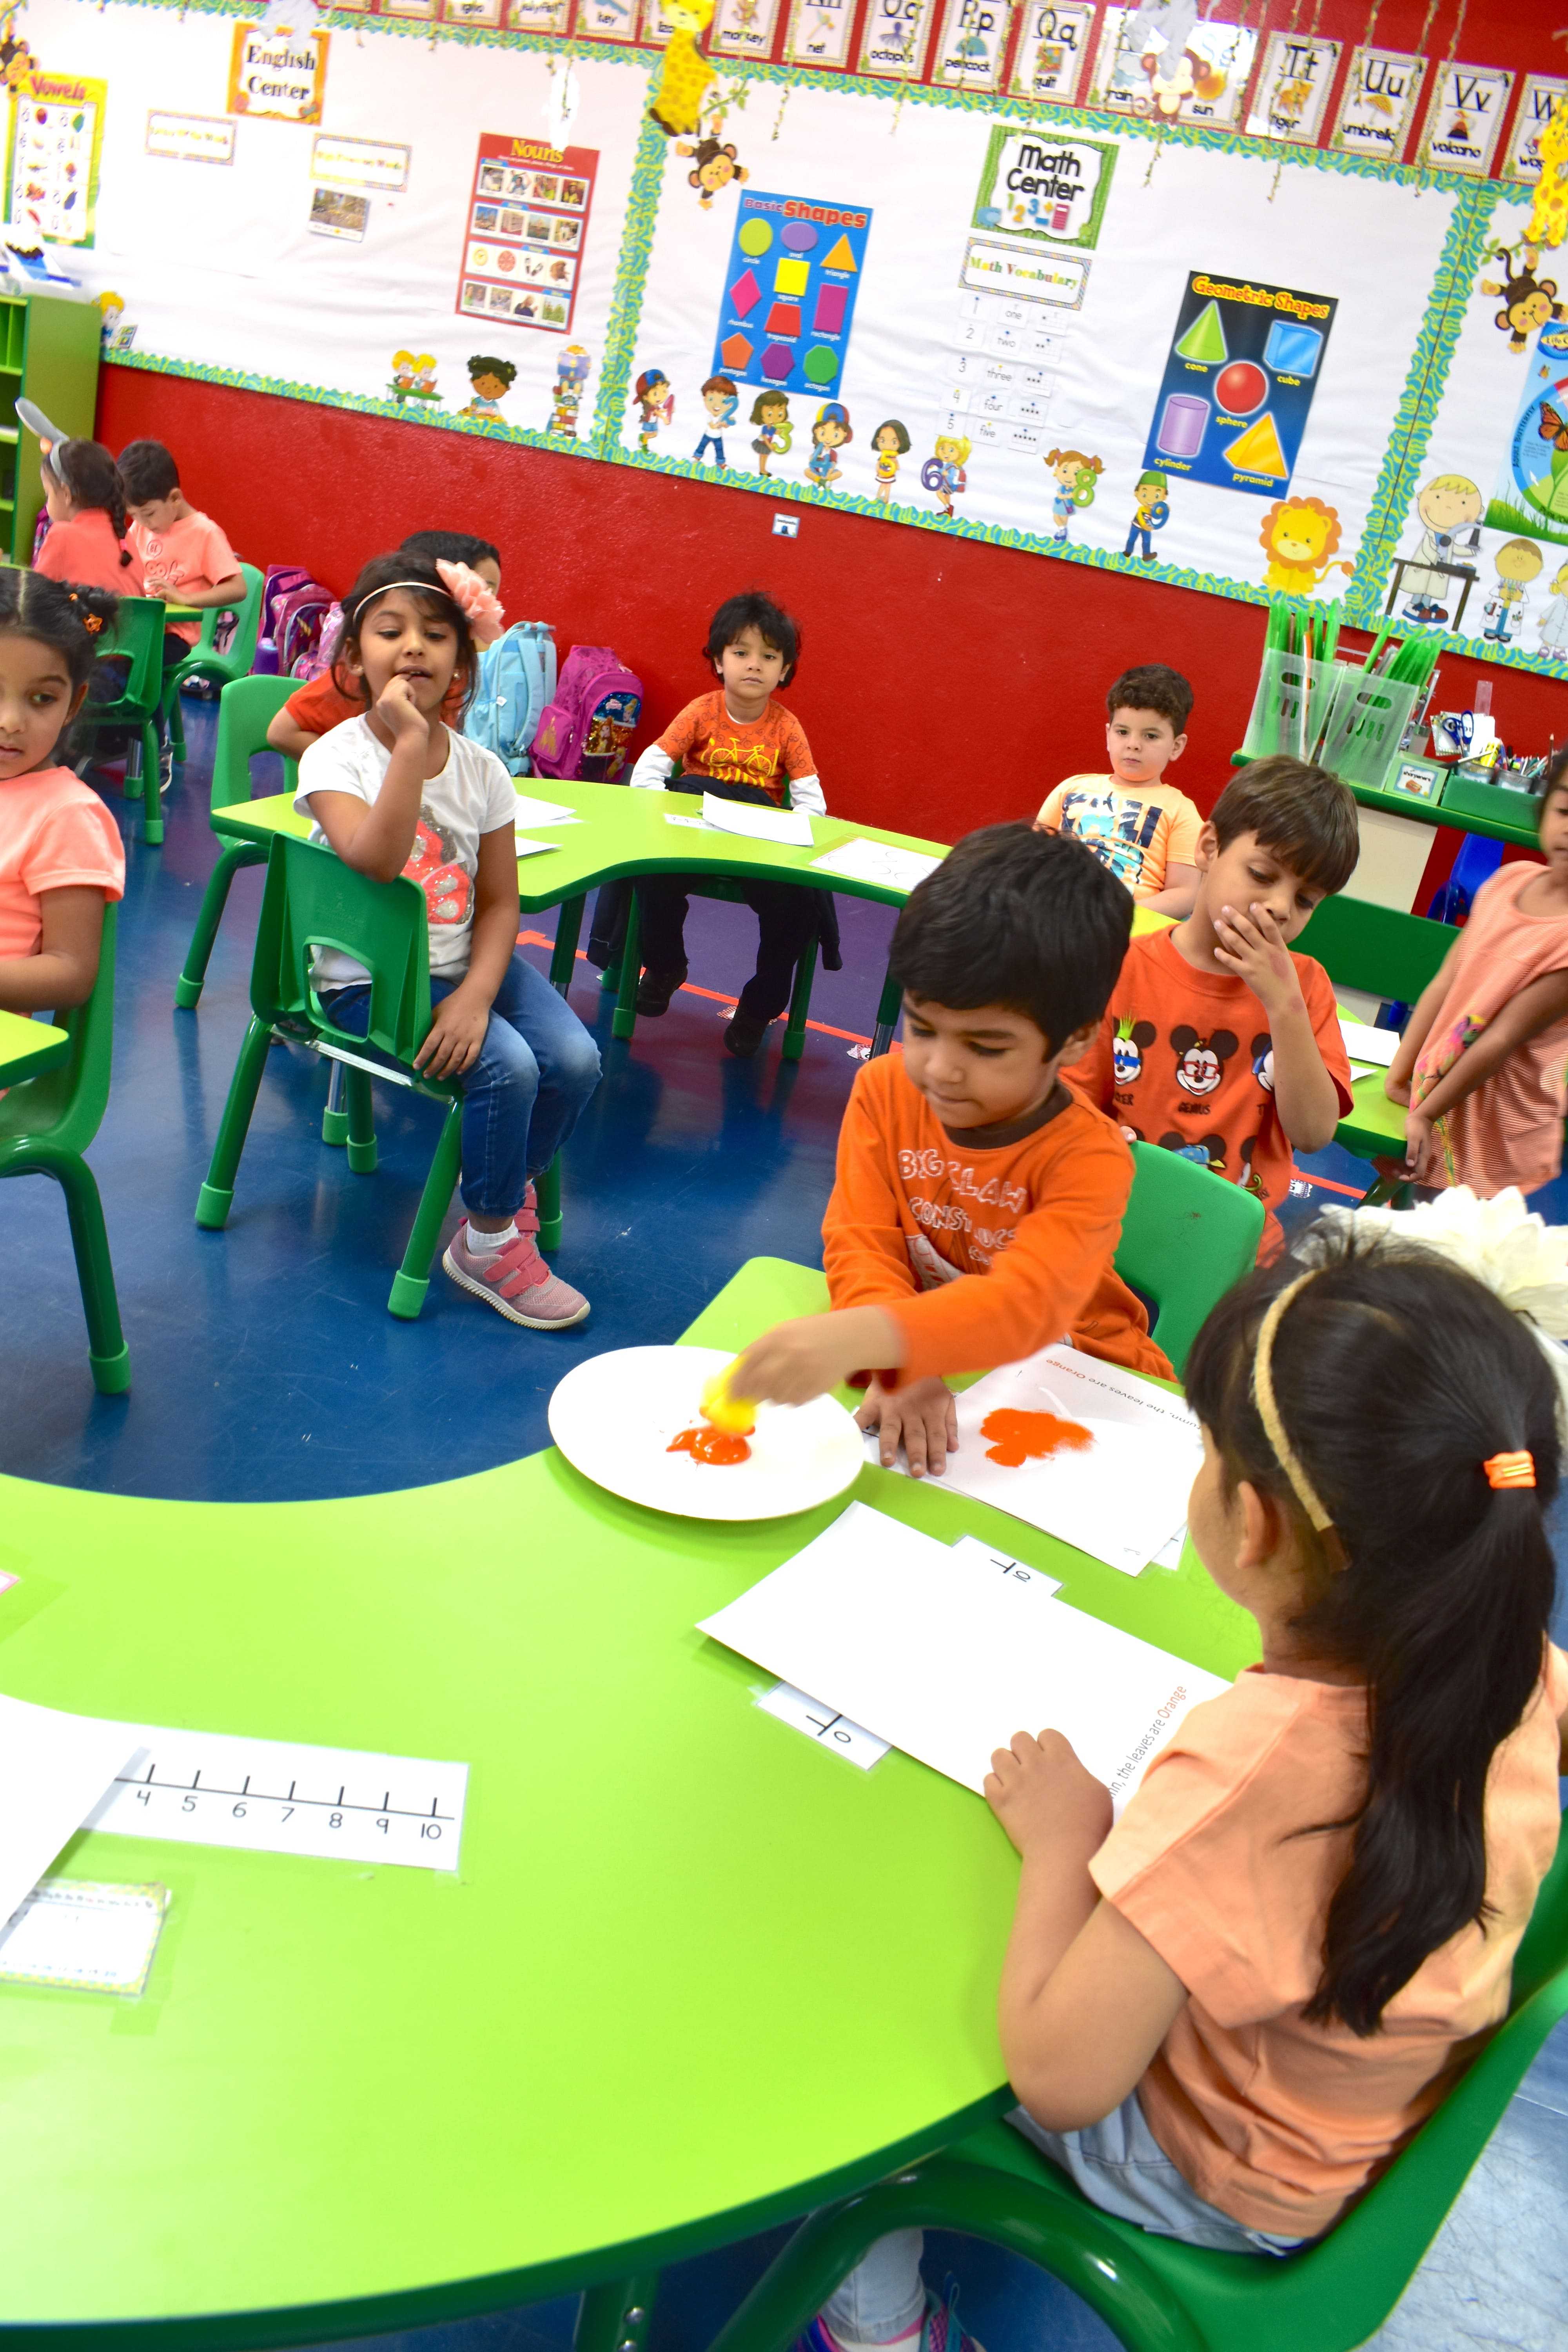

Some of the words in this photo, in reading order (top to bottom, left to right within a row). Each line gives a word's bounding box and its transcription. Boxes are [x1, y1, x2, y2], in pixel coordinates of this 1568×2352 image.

[598, 11, 617, 26] key
[722, 30, 766, 45] mokey
[1038, 10, 1077, 51] Qq
[807, 43, 826, 54] net
[247, 45, 316, 72] English
[945, 58, 991, 73] pecock
[1366, 59, 1404, 98] Uu
[30, 76, 87, 100] Vowels
[248, 76, 311, 100] Center
[1455, 74, 1492, 111] Vv
[1192, 104, 1214, 116] sun
[510, 139, 564, 163] Nouns
[1432, 140, 1481, 158] volcano
[1018, 143, 1081, 177] Math
[1006, 167, 1086, 202] Center
[744, 197, 784, 213] Basic
[782, 200, 867, 229] Shapes
[970, 256, 1003, 273] Math
[1007, 263, 1078, 290] Vocabulary
[1192, 275, 1275, 308] Geometric
[1274, 291, 1331, 321] Shapes
[1005, 310, 1023, 320] one
[966, 327, 975, 339] 2
[997, 338, 1016, 348] two
[958, 361, 967, 373] 3
[987, 367, 1013, 382] three
[1184, 361, 1209, 373] cone
[1276, 375, 1301, 387] cube
[984, 398, 1004, 411] four
[947, 418, 955, 430] 5
[1216, 415, 1248, 429] sphere
[772, 422, 794, 454] 3
[980, 425, 996, 438] five
[1154, 457, 1192, 472] cylinder
[921, 457, 944, 492] 6
[1232, 472, 1274, 488] pyramid
[1072, 468, 1098, 508] 8
[1403, 771, 1431, 782] sharpeners
[898, 1149, 945, 1180] BIG
[1046, 1359, 1086, 1379] Orange
[1089, 1377, 1107, 1387] are
[1109, 1387, 1144, 1405] leaves
[1146, 1403, 1165, 1414] the
[1157, 1686, 1187, 1719] Orange
[1149, 1719, 1165, 1735] are
[1125, 1734, 1155, 1763] leaves
[1116, 1762, 1136, 1779] the
[136, 1789, 151, 1806] 4
[181, 1795, 198, 1812] 5
[232, 1802, 247, 1818] 6
[281, 1806, 295, 1822] 7
[328, 1812, 343, 1828] 8
[376, 1818, 389, 1835] 9
[420, 1823, 442, 1840] 10
